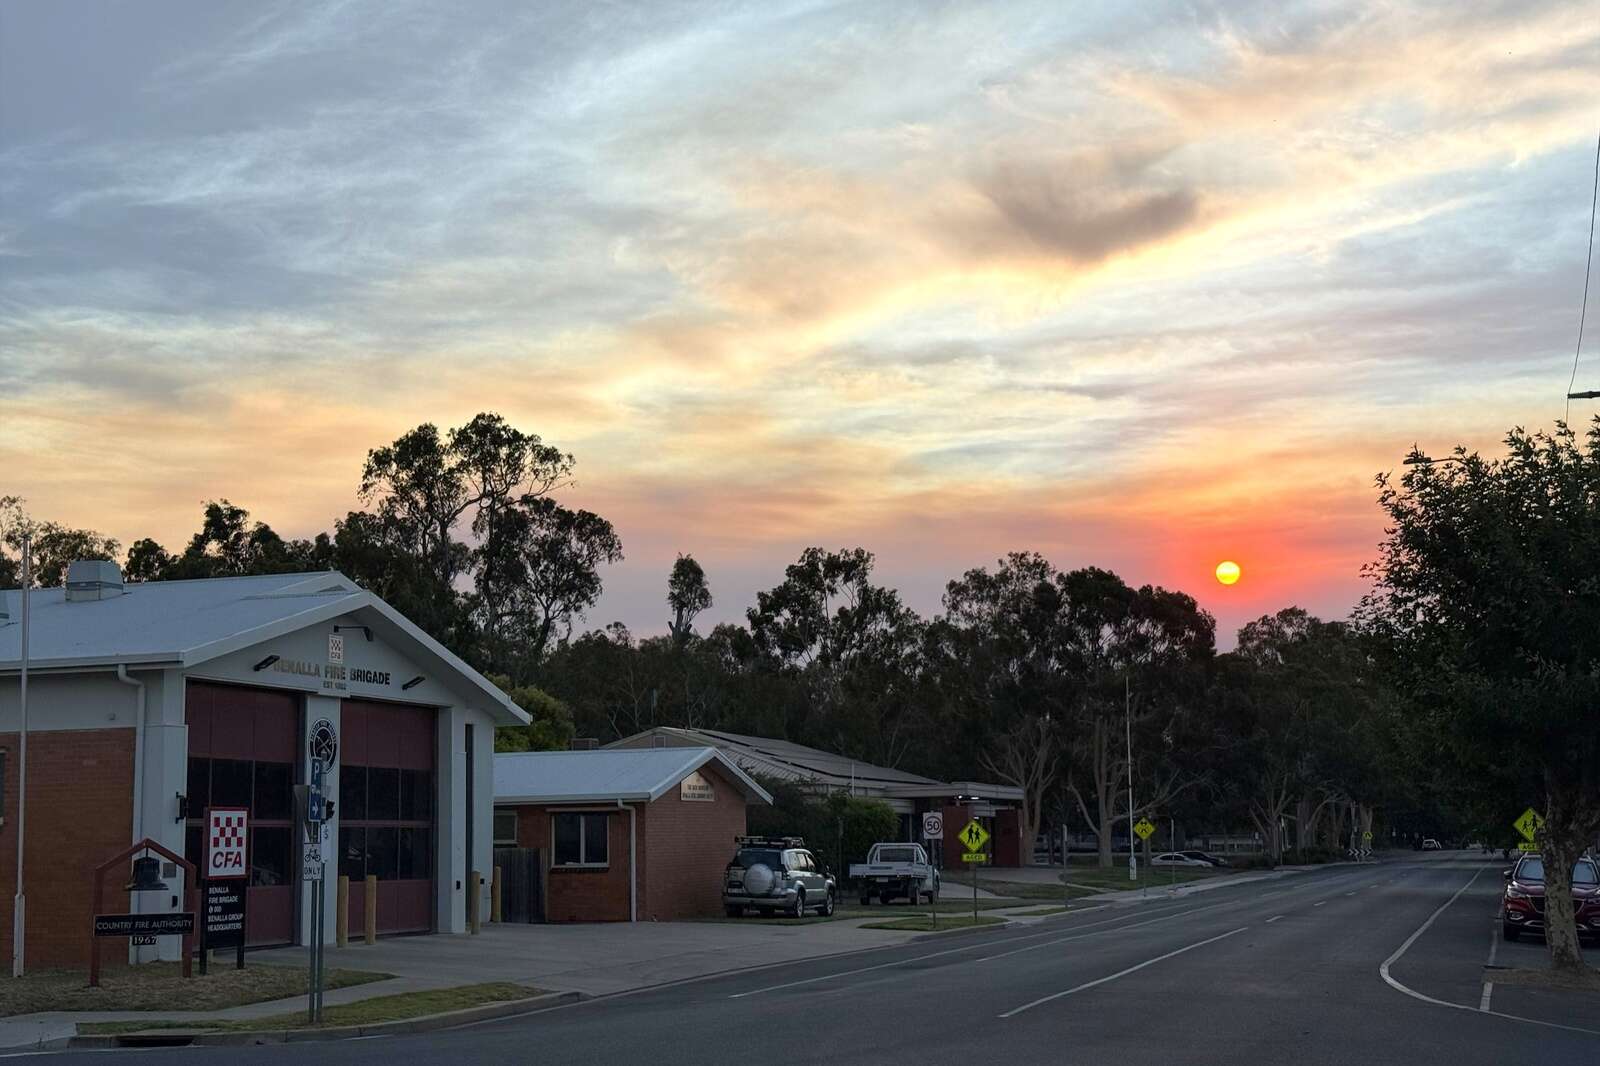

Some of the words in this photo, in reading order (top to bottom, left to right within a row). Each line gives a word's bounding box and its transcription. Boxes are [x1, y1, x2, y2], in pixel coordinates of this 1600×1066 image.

[273, 660, 321, 677] BENALLA
[324, 665, 346, 681] FIRE
[350, 668, 391, 685] BRIGADE
[927, 821, 939, 831] 50
[212, 851, 242, 868] CFA
[304, 866, 320, 875] ONLY
[208, 896, 218, 904] FIRE
[219, 895, 239, 903] BRIGADE
[208, 914, 227, 922] BENALLA
[228, 913, 243, 921] GROUP
[96, 920, 132, 930] COUNTRY
[134, 920, 150, 929] FIRE
[151, 919, 192, 928] AUTHORITY
[208, 922, 242, 932] HEADQUARTERS
[134, 936, 157, 945] 1967
